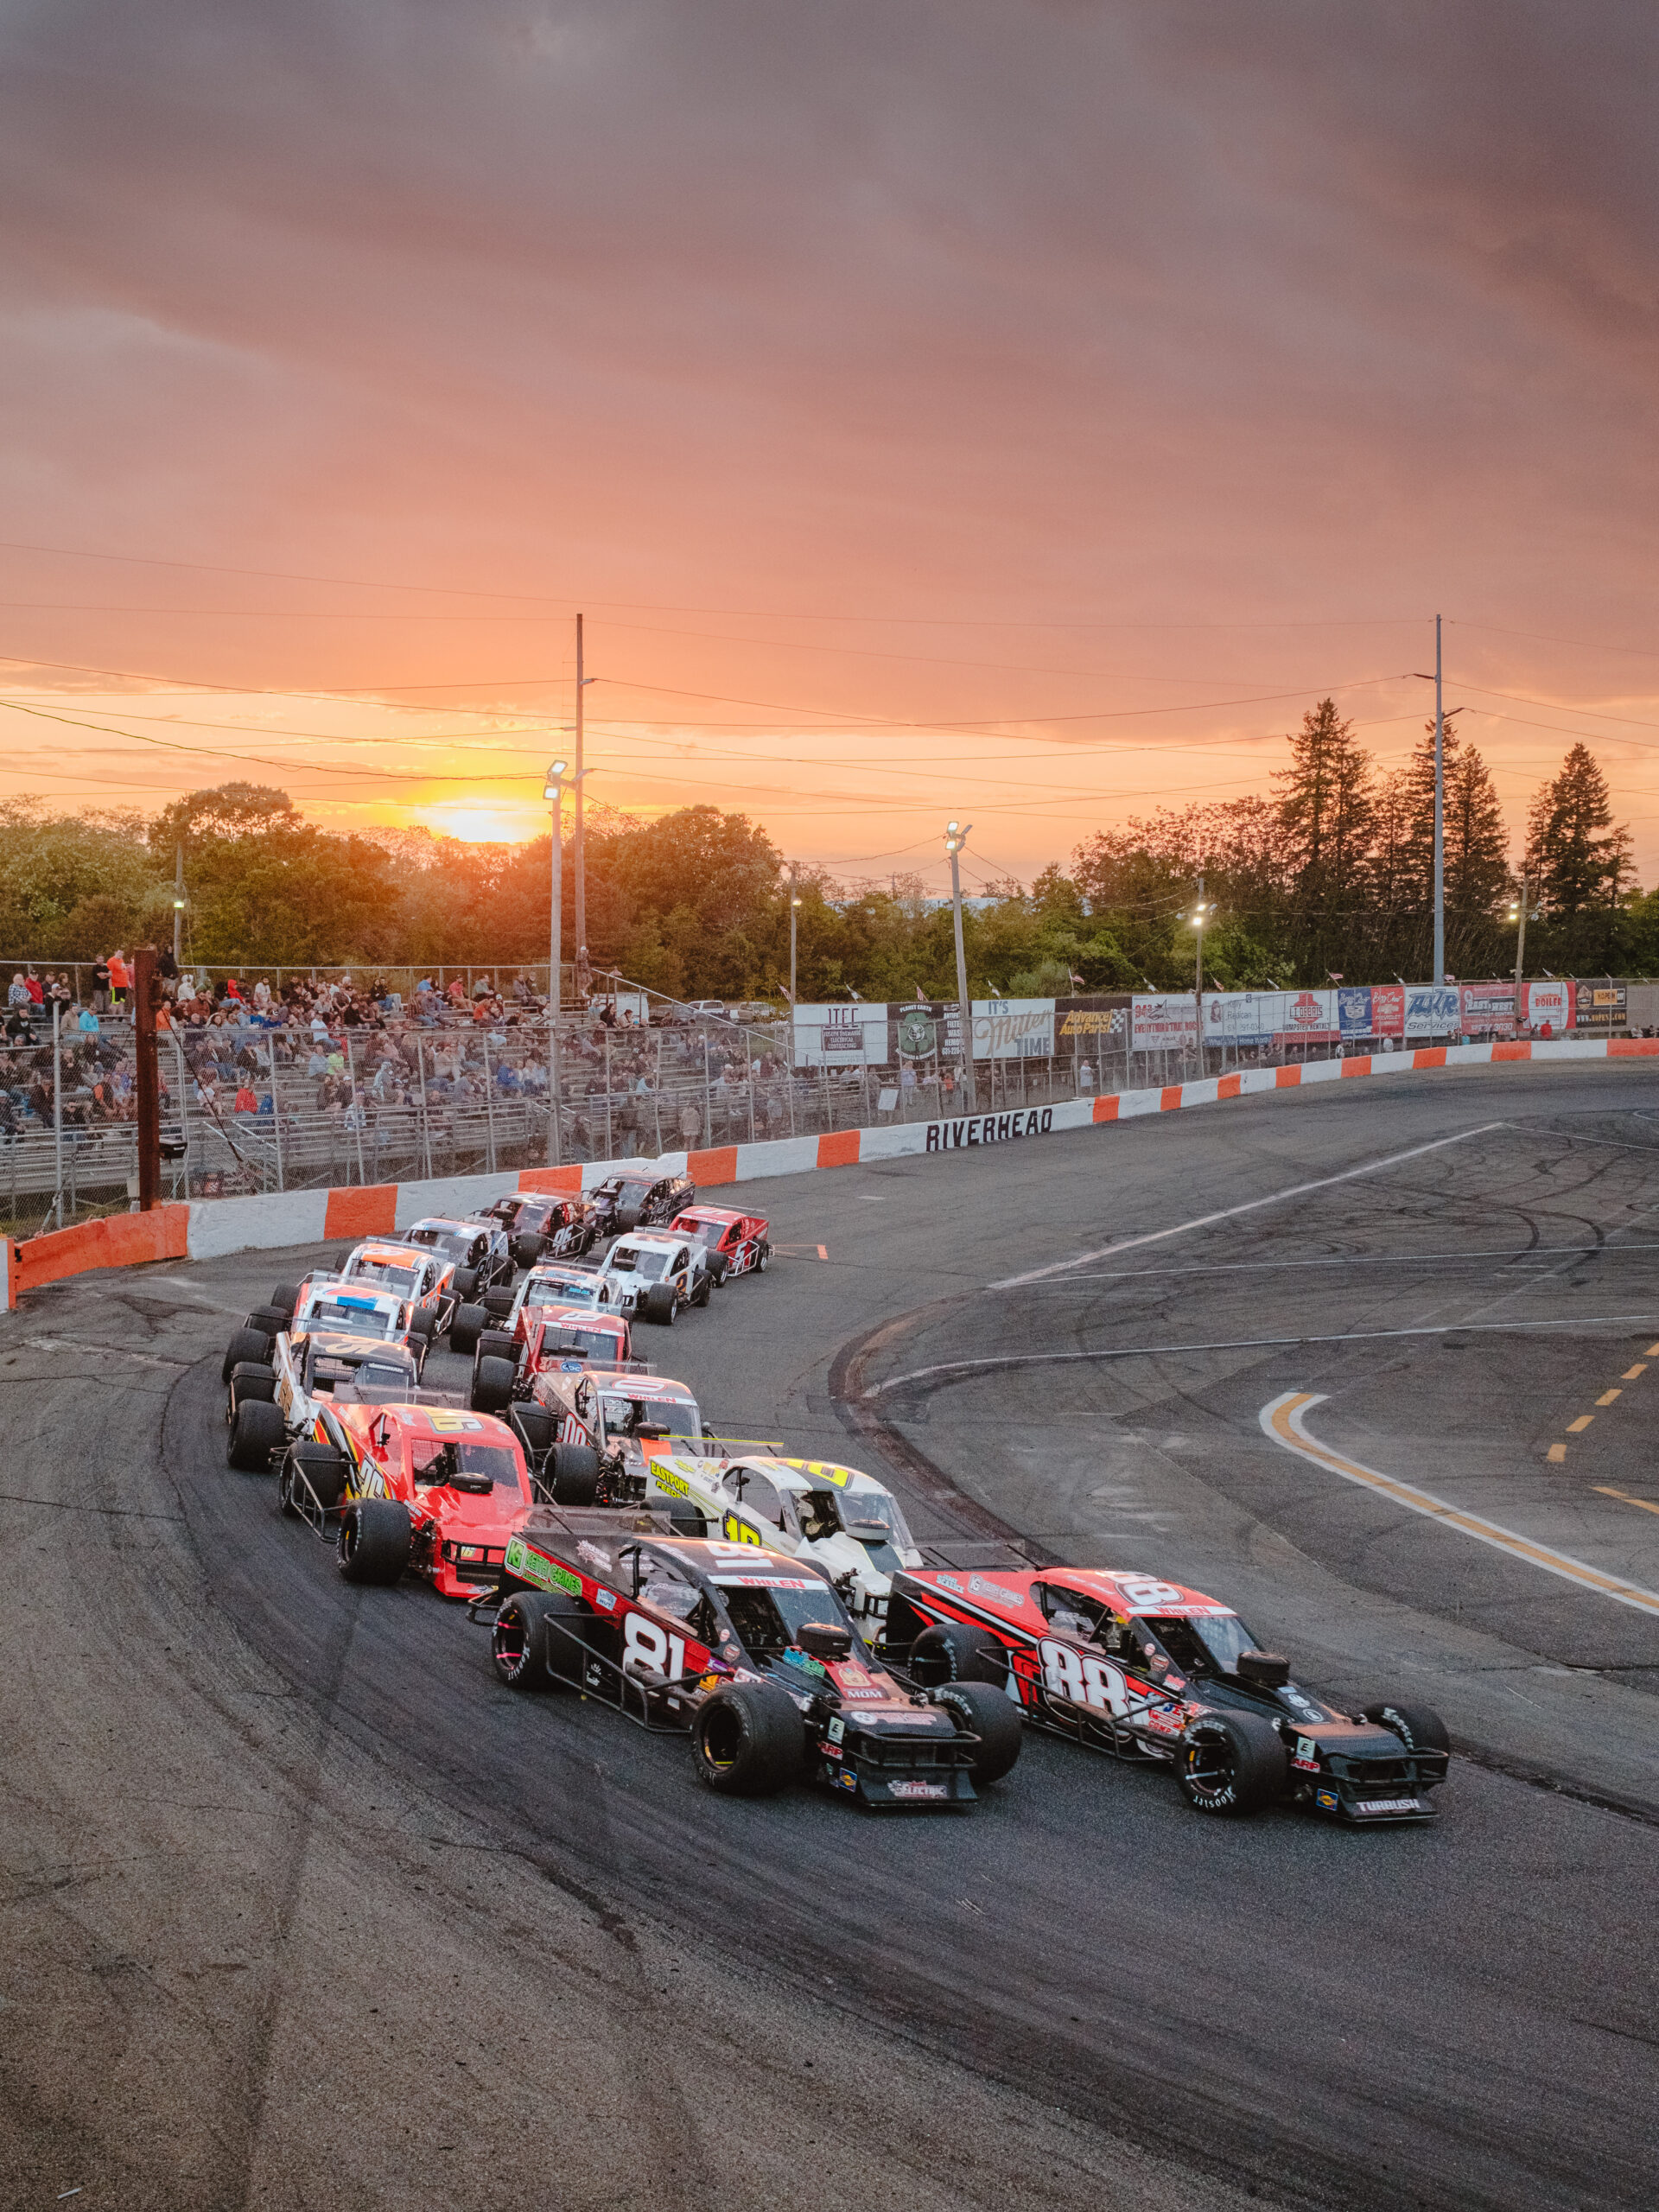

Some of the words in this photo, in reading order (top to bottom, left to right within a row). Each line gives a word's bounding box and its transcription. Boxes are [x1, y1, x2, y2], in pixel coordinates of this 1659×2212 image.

[988, 1001, 1008, 1014] IT'S
[825, 1007, 858, 1028] JTEC
[1065, 1009, 1109, 1024] Advance
[975, 1009, 1052, 1056] Miller
[1059, 1024, 1083, 1035] Auto
[1014, 1037, 1051, 1056] TIME
[927, 1108, 1053, 1152] RIVERHEAD
[561, 1322, 601, 1334] WHELEN
[627, 1393, 677, 1403] WHELEN
[651, 1460, 690, 1497] EASTPORT
[550, 1563, 583, 1596] GRIMES
[737, 1576, 806, 1589] WHELEN
[1156, 1606, 1211, 1616] WHELEN
[623, 1611, 685, 1682] 81
[1039, 1639, 1134, 1725] 88
[847, 1690, 882, 1699] MOM
[831, 1724, 839, 1733] E
[1300, 1743, 1308, 1751] E
[1291, 1758, 1319, 1770] ARP
[902, 1784, 945, 1796] ELECTRIC
[1193, 1785, 1237, 1808] Hoosier
[1356, 1799, 1421, 1812] TURBUSH
